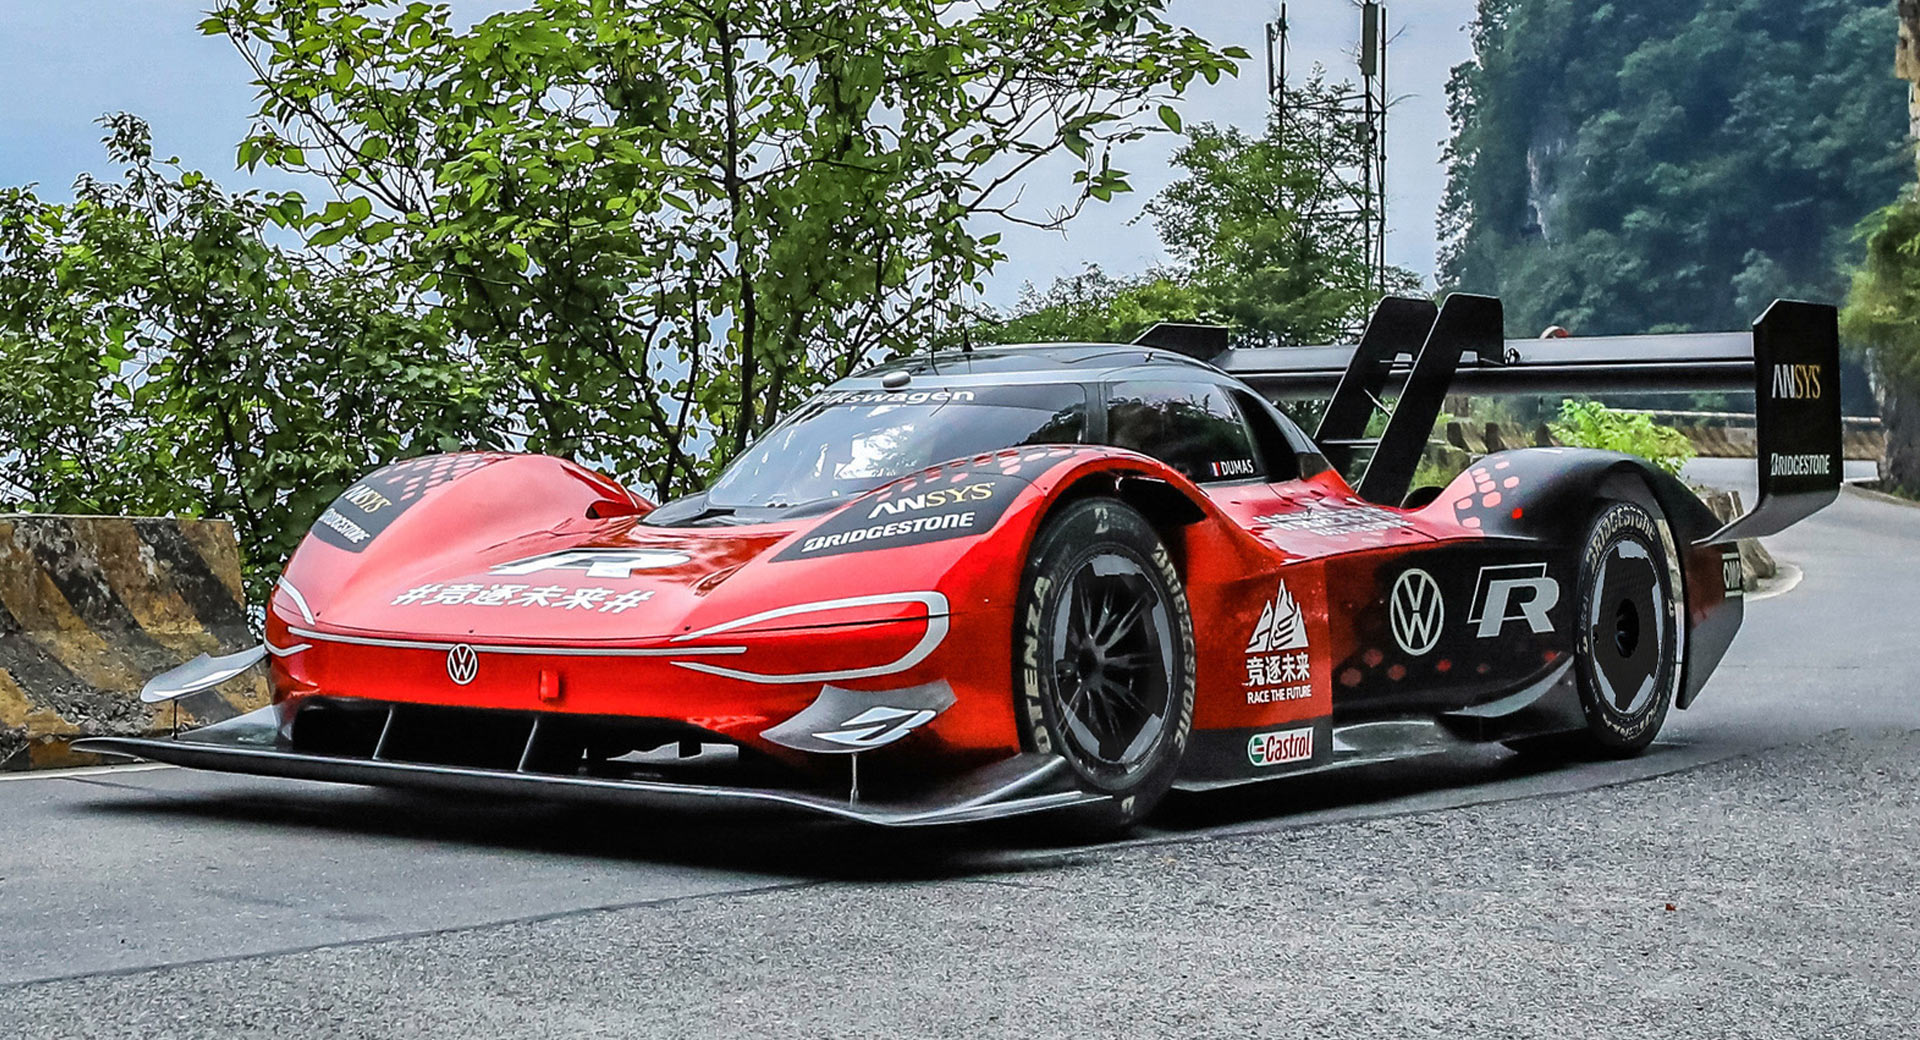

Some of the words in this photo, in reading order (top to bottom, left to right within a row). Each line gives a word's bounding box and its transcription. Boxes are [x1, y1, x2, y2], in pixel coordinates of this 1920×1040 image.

[1772, 364, 1821, 399] ANSYS
[1220, 459, 1255, 476] DUMAS
[1770, 453, 1830, 476] BRIDGESTONE
[868, 482, 995, 519] ANSYS
[801, 512, 976, 552] BRIDGESTONE
[1471, 566, 1560, 639] R
[1024, 576, 1051, 754] OTENZA
[1243, 651, 1310, 687] 竞逐未来
[1247, 690, 1270, 704] RACE
[1271, 687, 1286, 702] THE
[1286, 684, 1312, 700] FUTURE
[1265, 730, 1311, 763] Castrol
